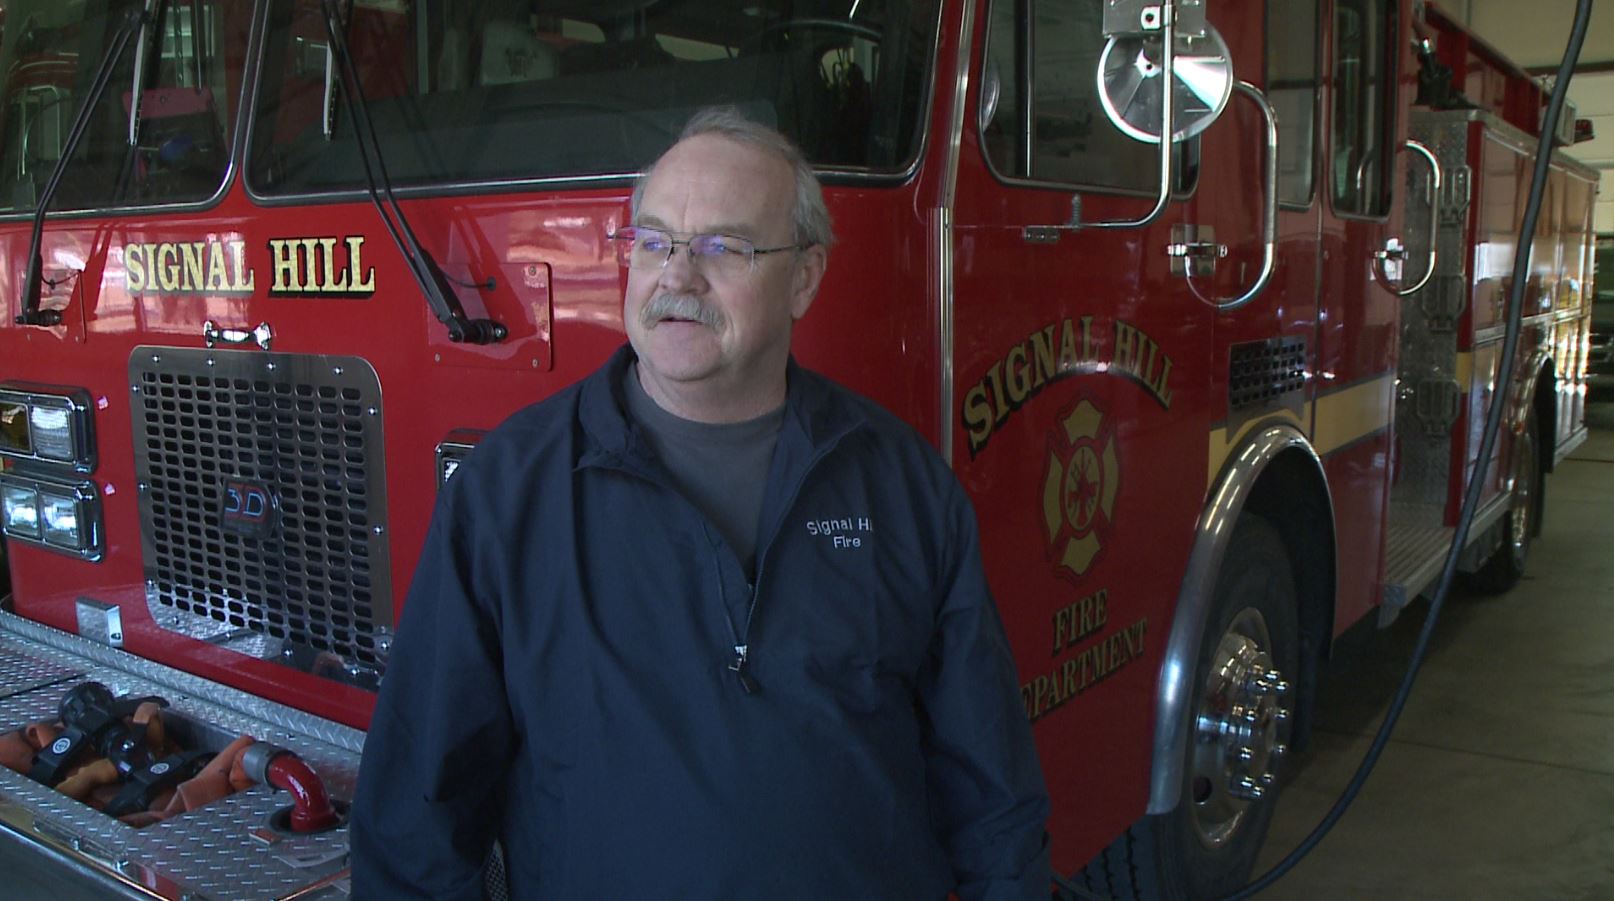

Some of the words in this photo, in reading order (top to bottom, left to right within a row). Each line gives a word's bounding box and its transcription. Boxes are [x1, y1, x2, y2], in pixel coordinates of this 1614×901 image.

[124, 240, 255, 294] SIGNAL
[268, 236, 376, 296] HILL
[963, 315, 1100, 455] SIGNAL
[1114, 319, 1175, 410] HILL
[806, 518, 853, 535] Signal
[858, 517, 873, 531] Hi
[833, 535, 861, 549] Fire
[1053, 588, 1107, 653] FIRE
[1020, 617, 1147, 722] EPARTMENT
